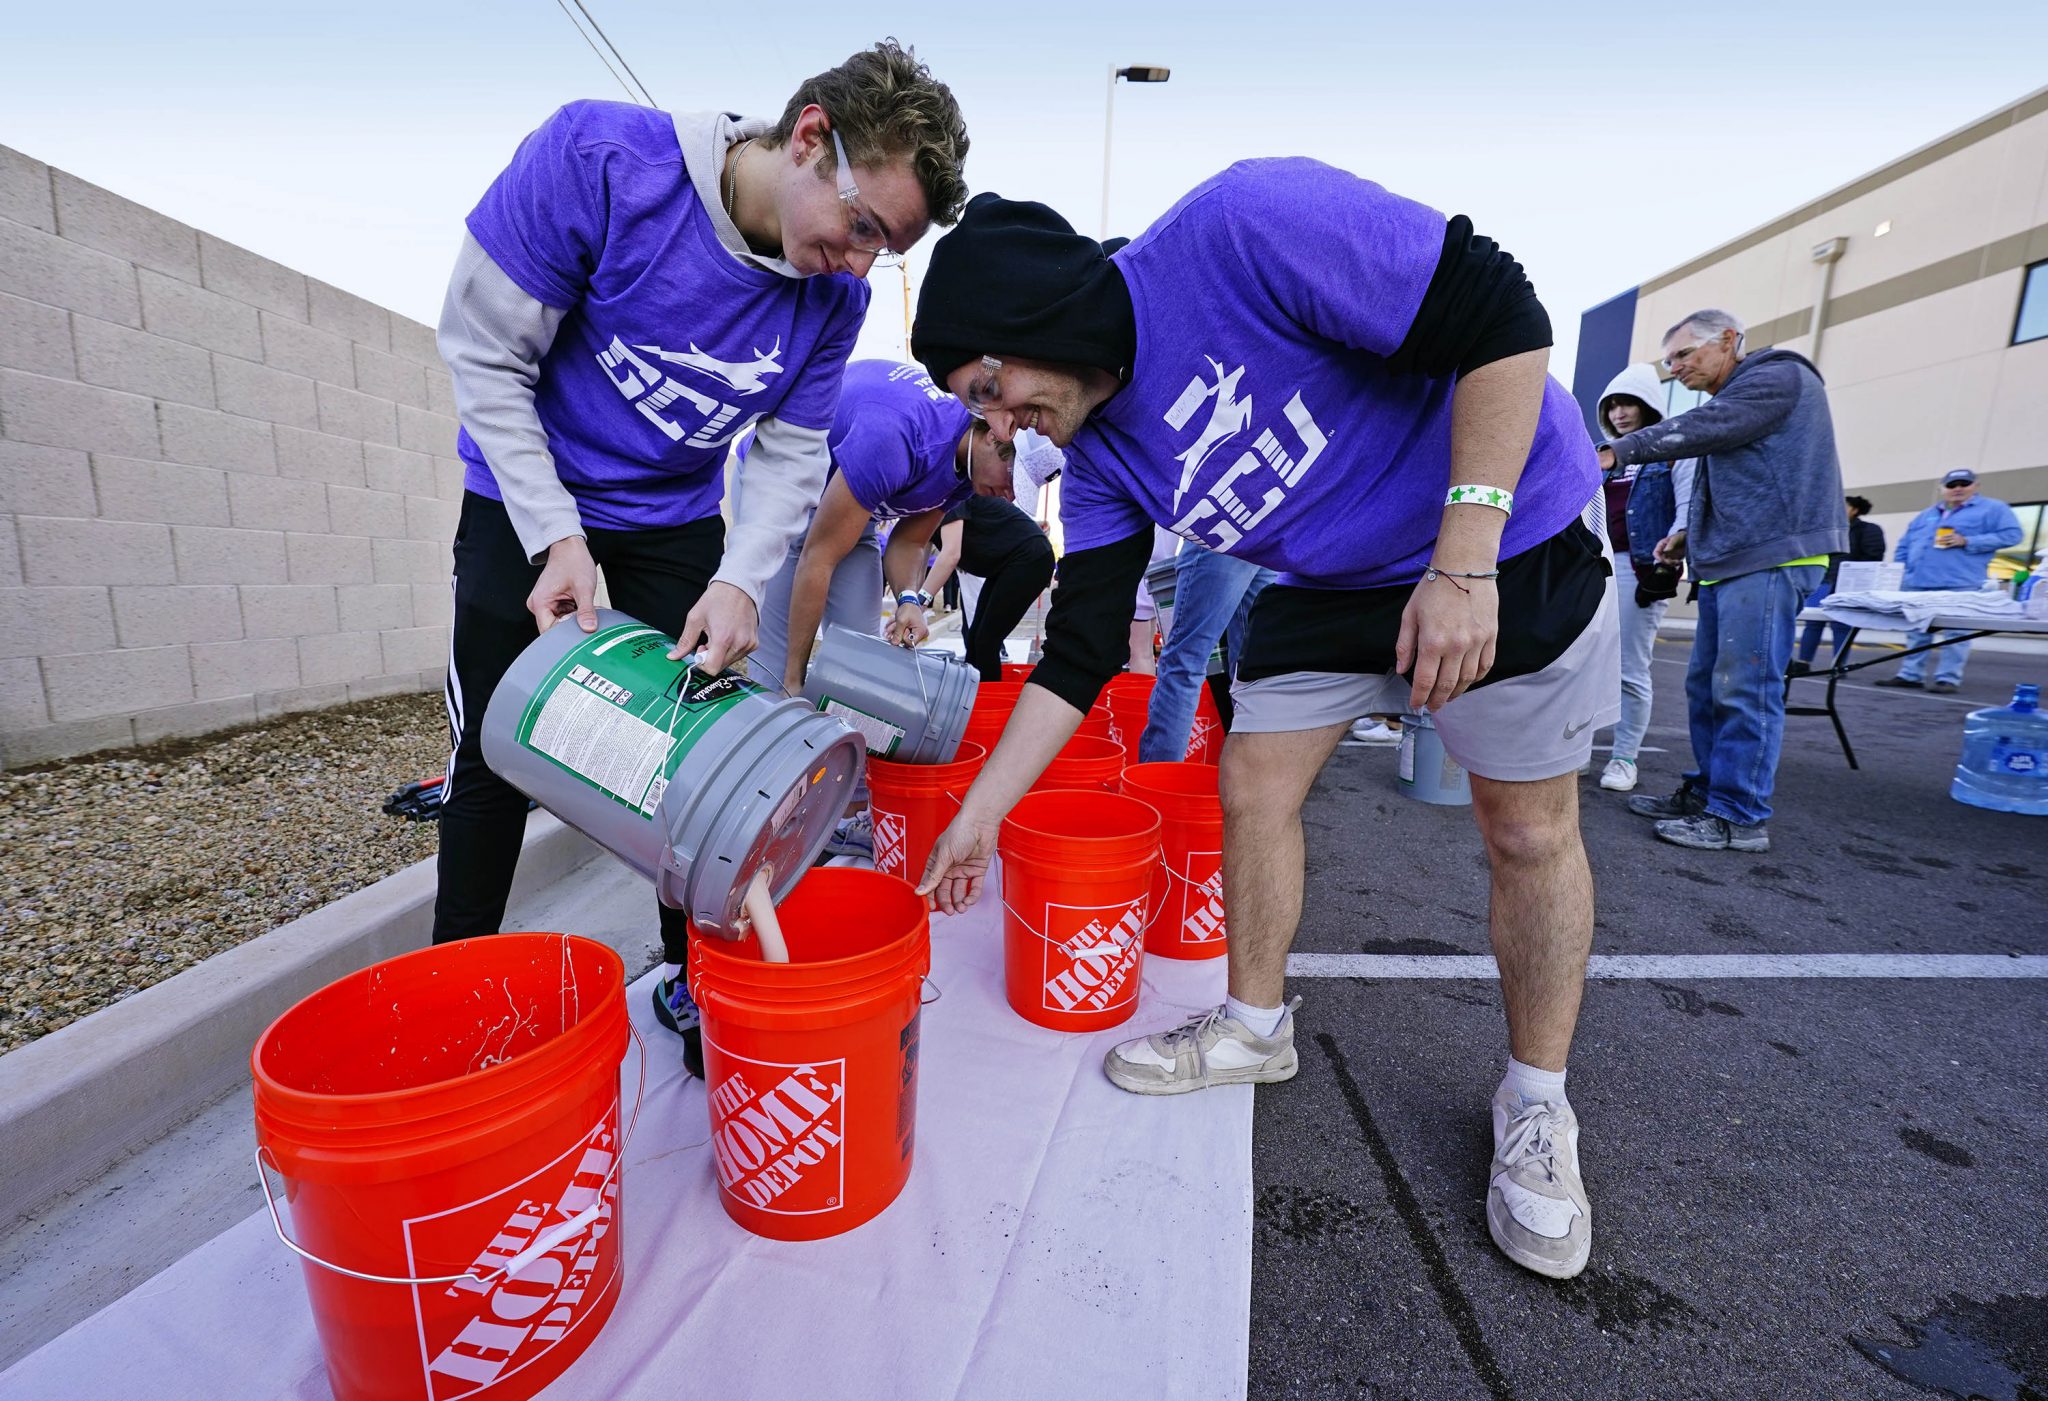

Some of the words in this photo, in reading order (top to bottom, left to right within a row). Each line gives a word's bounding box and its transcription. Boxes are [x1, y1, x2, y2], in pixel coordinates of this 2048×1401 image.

[1045, 899, 1147, 1012] HOME
[1057, 918, 1108, 960] THE
[1087, 935, 1142, 1010] DEPOT
[711, 1072, 757, 1121] THE
[712, 1064, 842, 1189] HOME
[743, 1119, 841, 1208] DEPOT
[428, 1123, 618, 1387] HOME
[445, 1199, 552, 1297] THE
